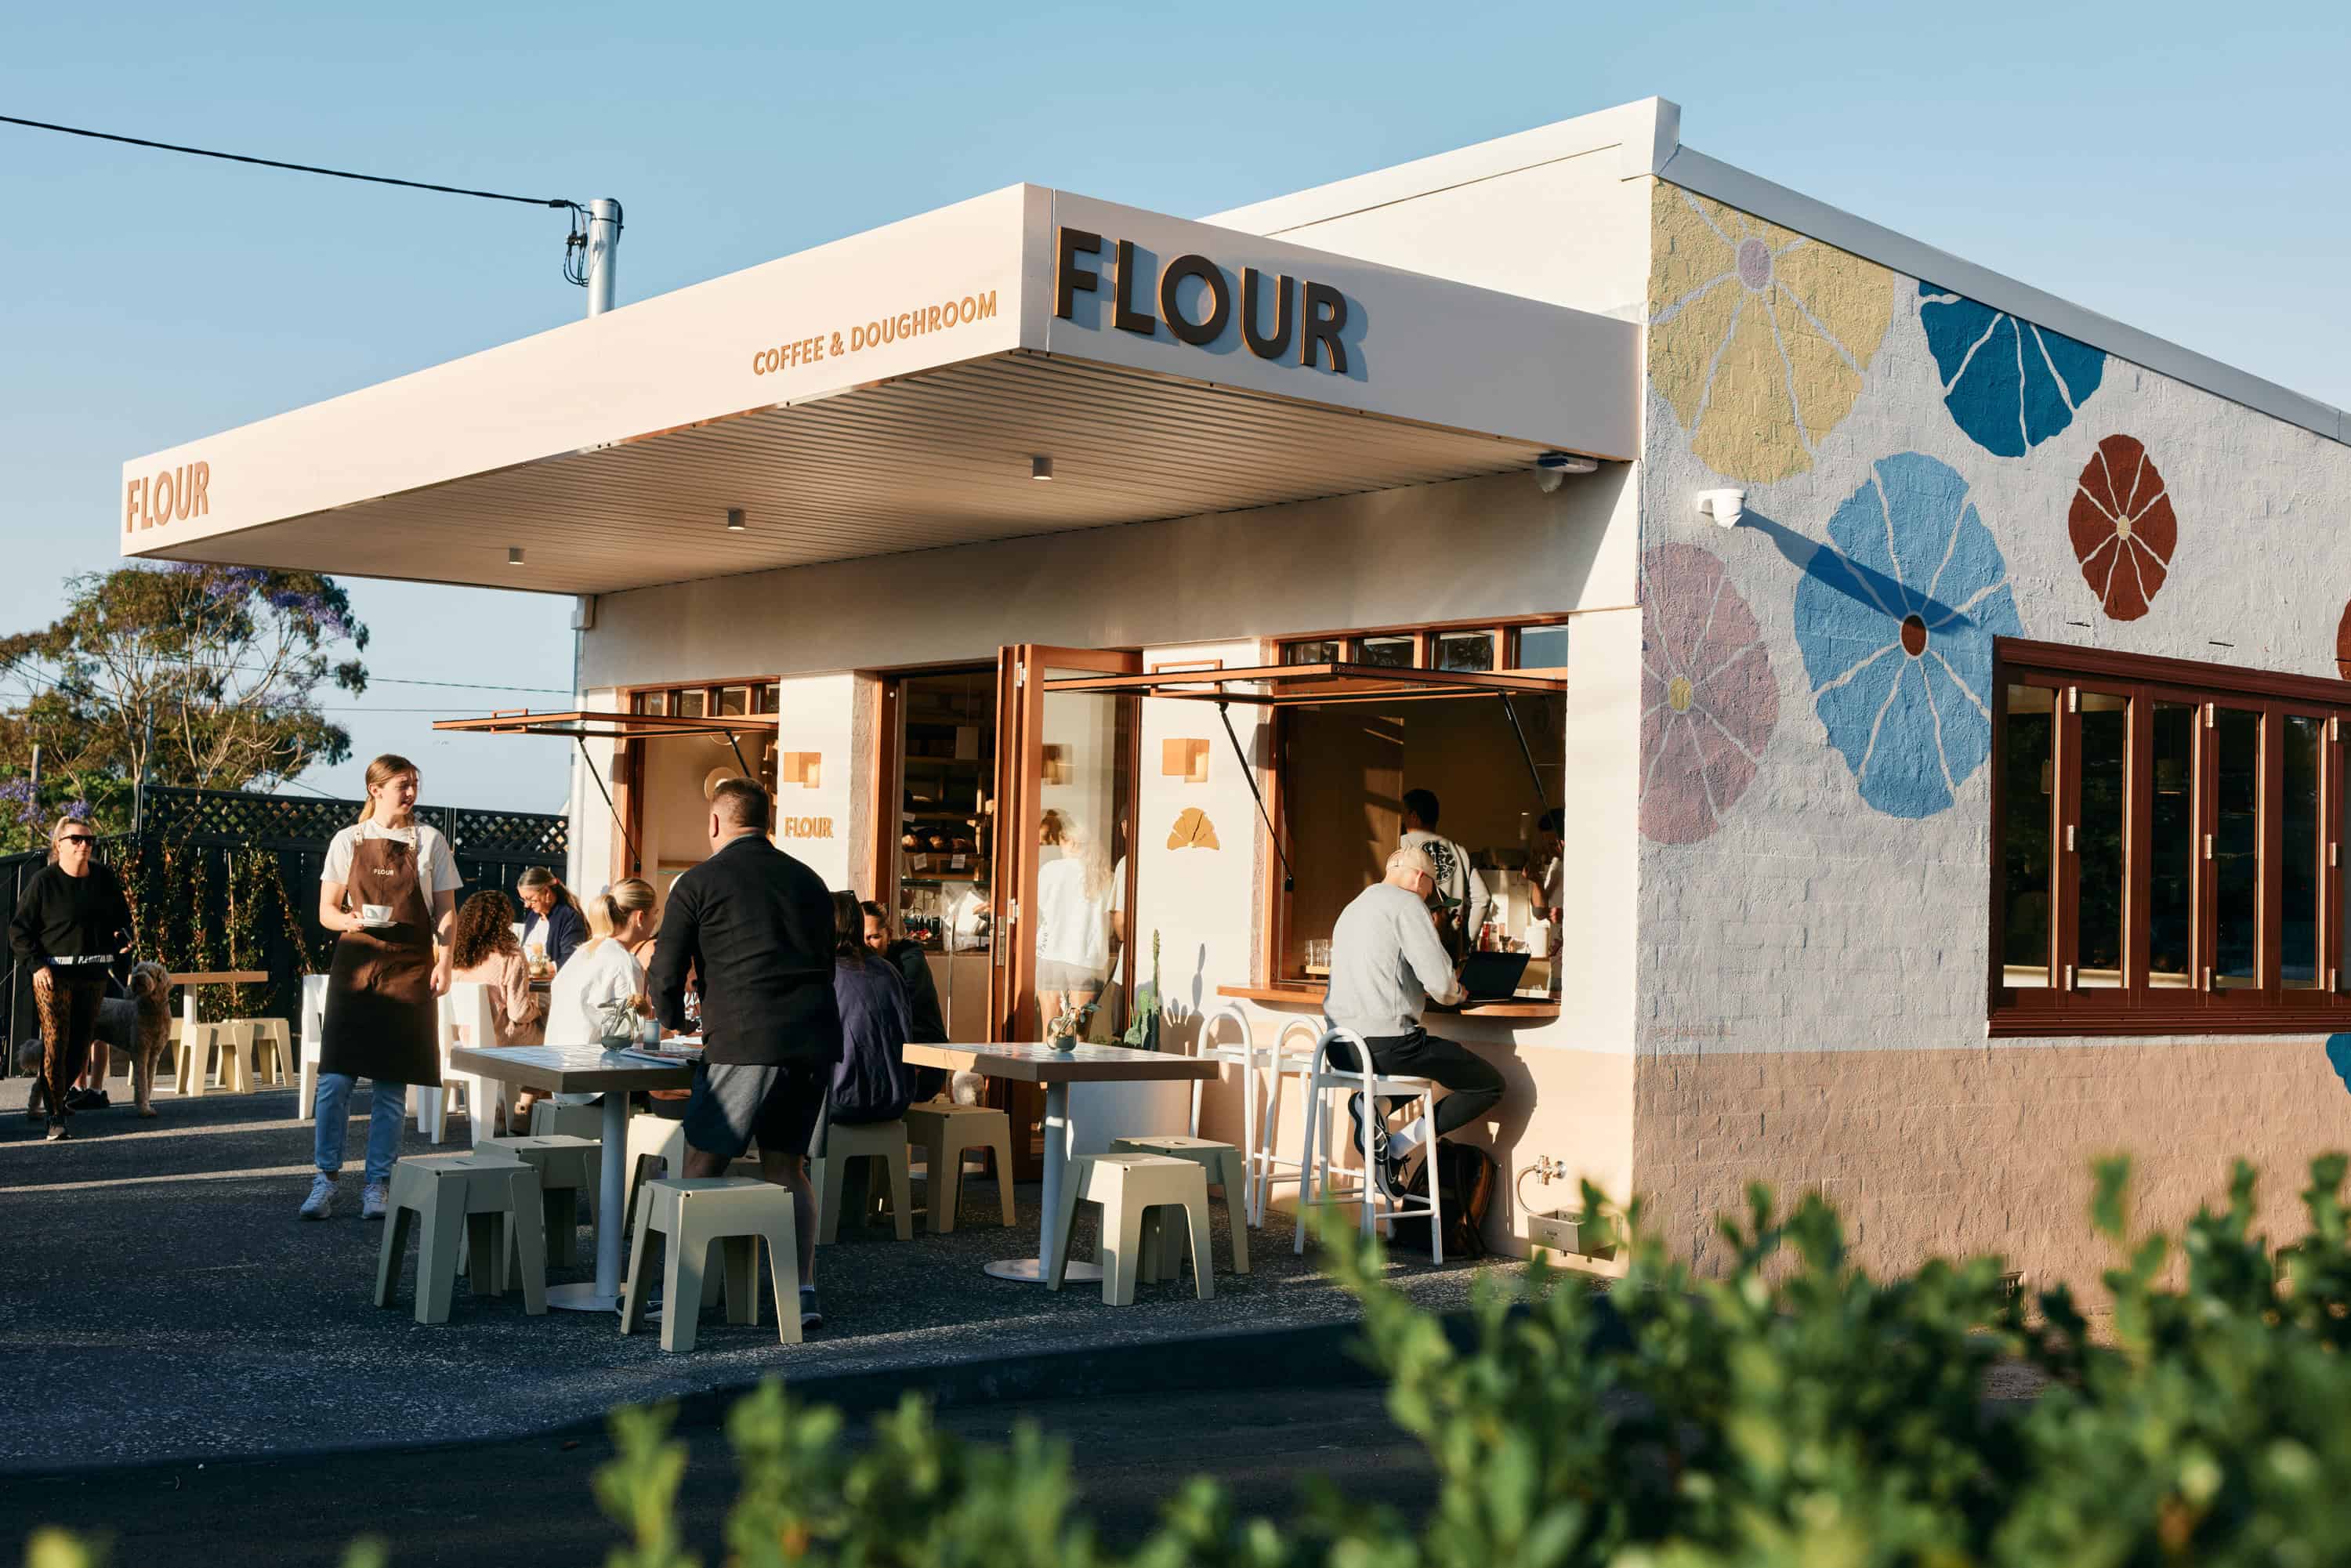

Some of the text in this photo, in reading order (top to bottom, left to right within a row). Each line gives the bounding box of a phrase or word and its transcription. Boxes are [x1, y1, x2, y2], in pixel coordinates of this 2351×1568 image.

[753, 290, 997, 375] COFFEE & DOUGHROOM
[1055, 226, 1347, 372] FLOUR
[126, 461, 209, 533] FLOUR
[784, 817, 833, 838] FLOUR
